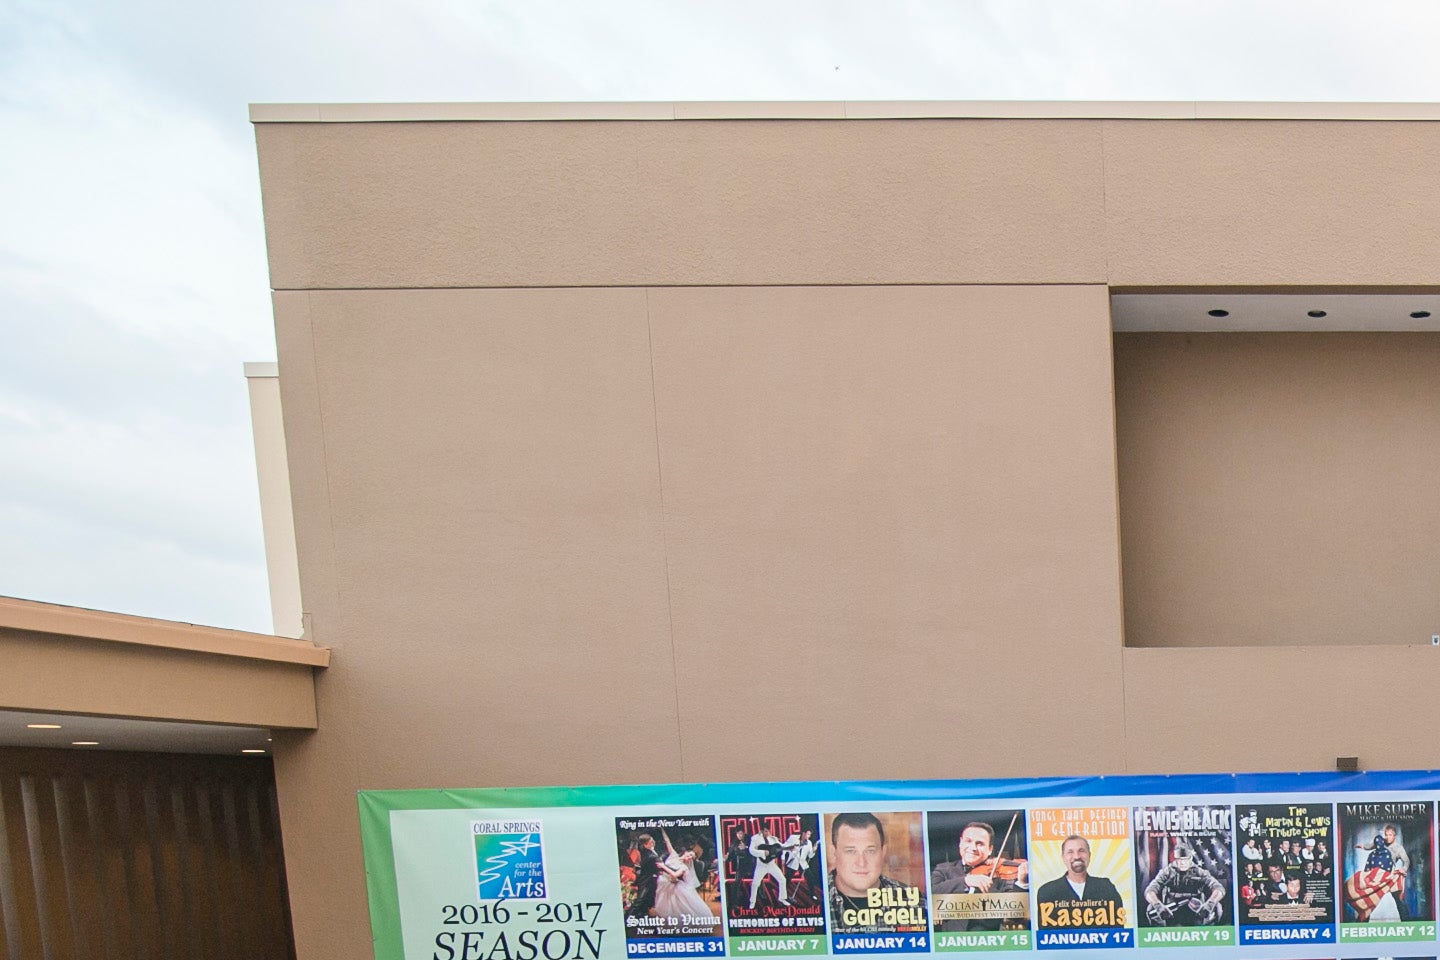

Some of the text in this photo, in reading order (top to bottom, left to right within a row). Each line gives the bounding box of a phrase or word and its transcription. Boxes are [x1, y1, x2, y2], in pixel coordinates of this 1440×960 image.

[1031, 809, 1127, 821] SONGS THAT DEFINED
[1346, 803, 1426, 816] MIKE SUPER
[620, 818, 710, 830] Ring in the New Year with
[1135, 809, 1231, 831] LEWIS BLACK
[1295, 817, 1302, 827] &
[474, 822, 540, 833] CORAL SPRINGS
[1035, 821, 1126, 836] A GENERATION
[515, 861, 541, 869] center
[514, 869, 542, 878] for the
[498, 875, 544, 898] Arts
[1054, 899, 1107, 908] Felix Cavaliere's
[442, 898, 511, 925] 2016
[536, 902, 603, 927] 2017
[730, 905, 821, 918] Chris MacDonald
[1040, 901, 1126, 927] Rascals
[626, 913, 721, 927] Salute to Vienna
[729, 916, 824, 928] MEMORIES OF ELVIS
[637, 926, 713, 935] New Year's Concert
[1144, 930, 1229, 942] JANUARY 19
[1245, 928, 1331, 940] FEBRUARY 4
[1341, 926, 1435, 938] FEBRUARY 12
[836, 937, 926, 949] JANUARY 14
[938, 934, 1028, 947] JANUARY 15
[1040, 932, 1129, 945] JANUARY 17
[628, 941, 724, 954] DECEMBER 31
[738, 939, 819, 951] JANUARY 7
